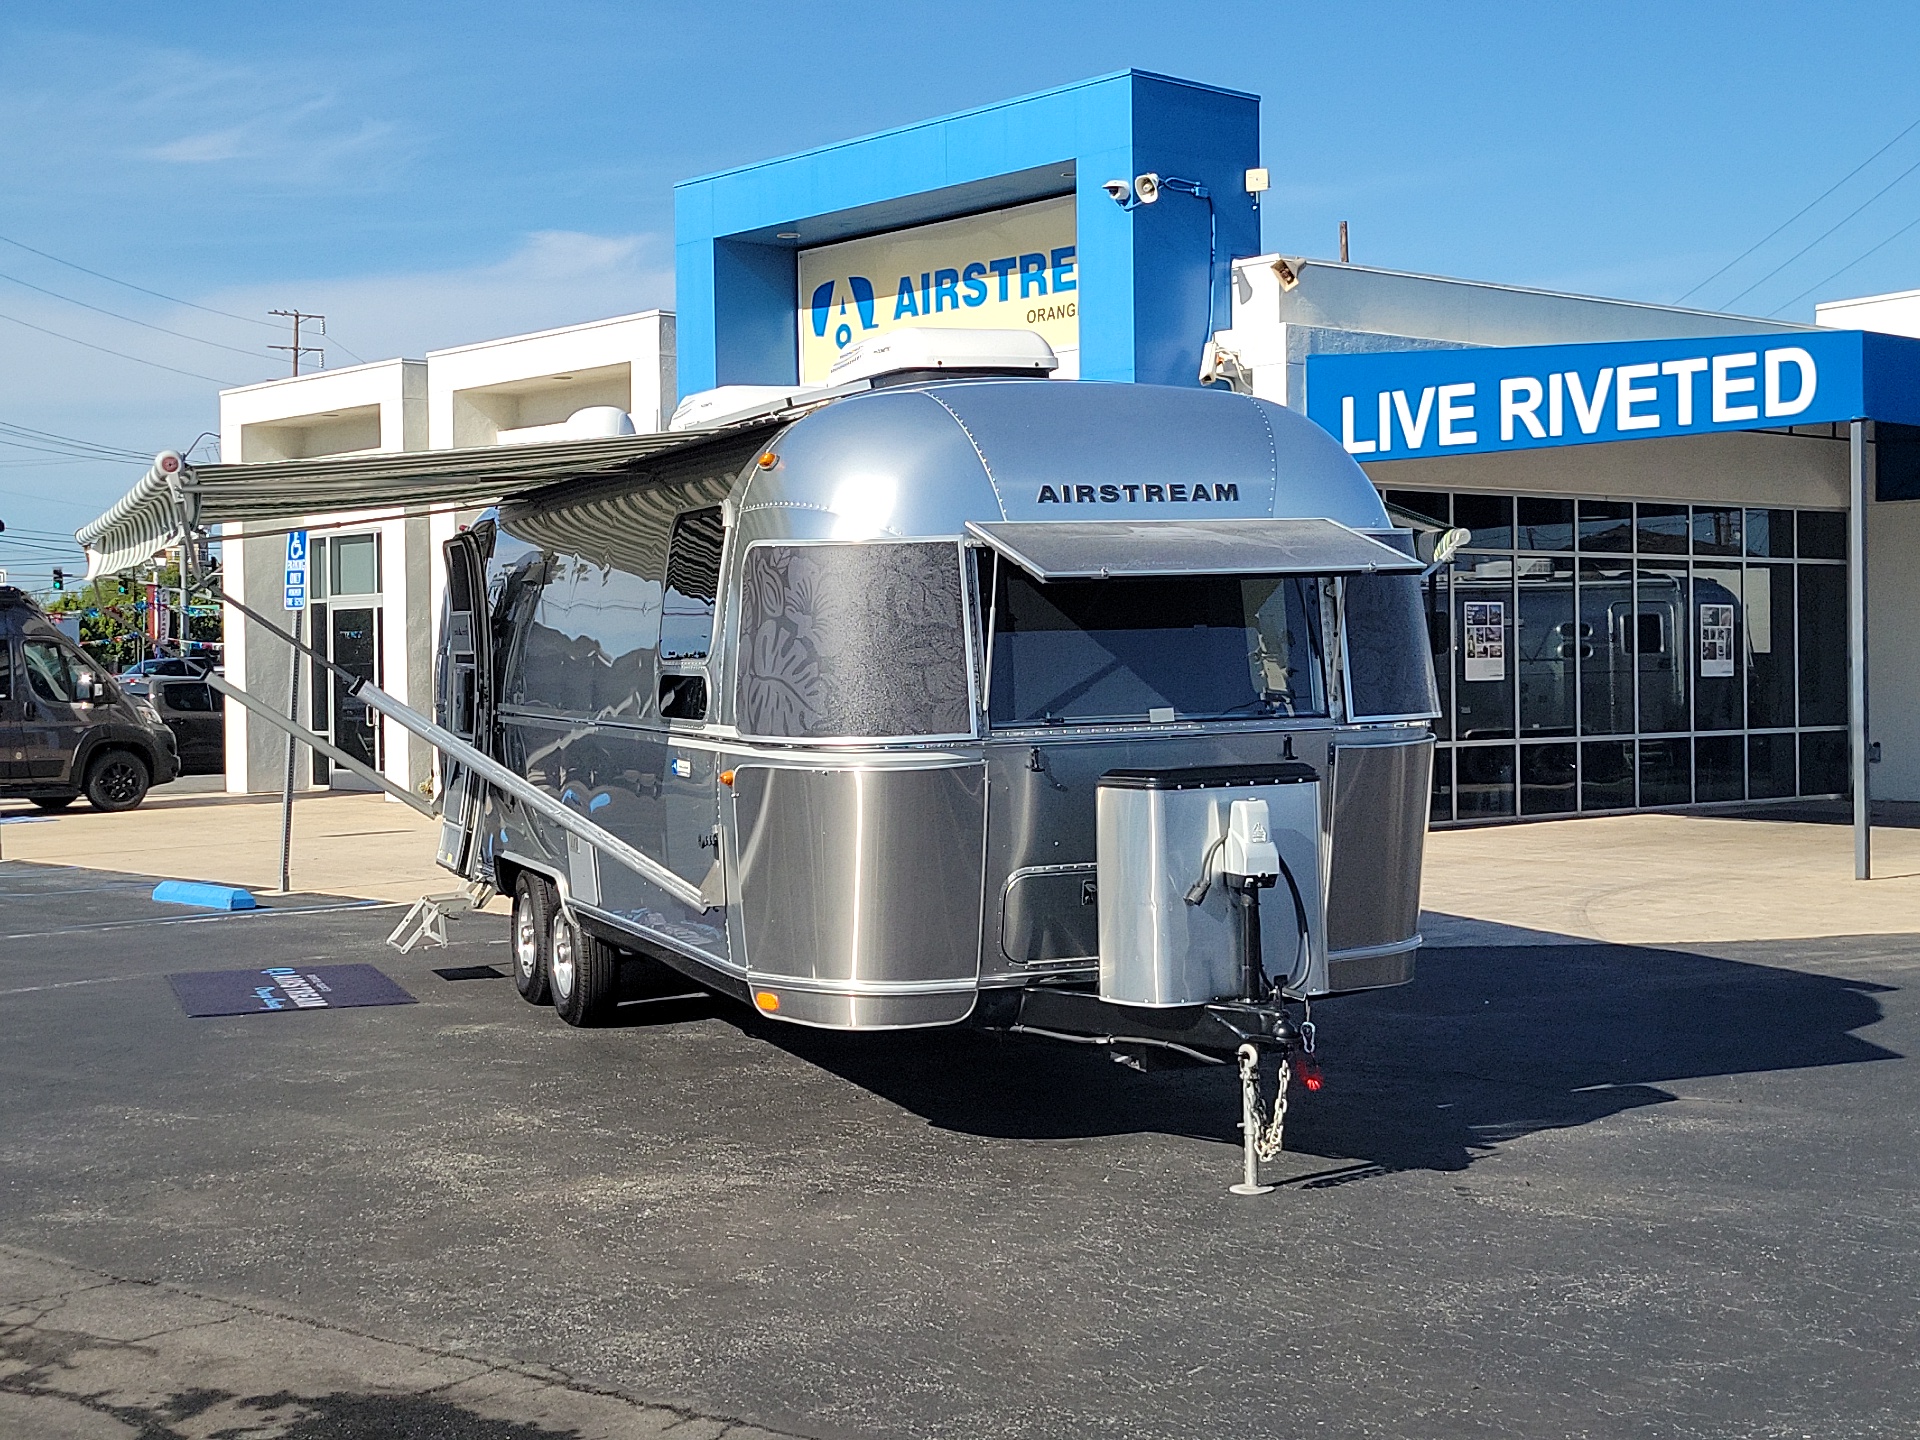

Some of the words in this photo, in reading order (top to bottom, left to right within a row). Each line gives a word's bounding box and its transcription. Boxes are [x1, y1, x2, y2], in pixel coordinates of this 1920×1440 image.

[1026, 302, 1079, 324] ORANG
[1341, 382, 1477, 455] LIVE
[1499, 346, 1818, 442] RIVETED
[1036, 483, 1240, 504] AIRSTREAM
